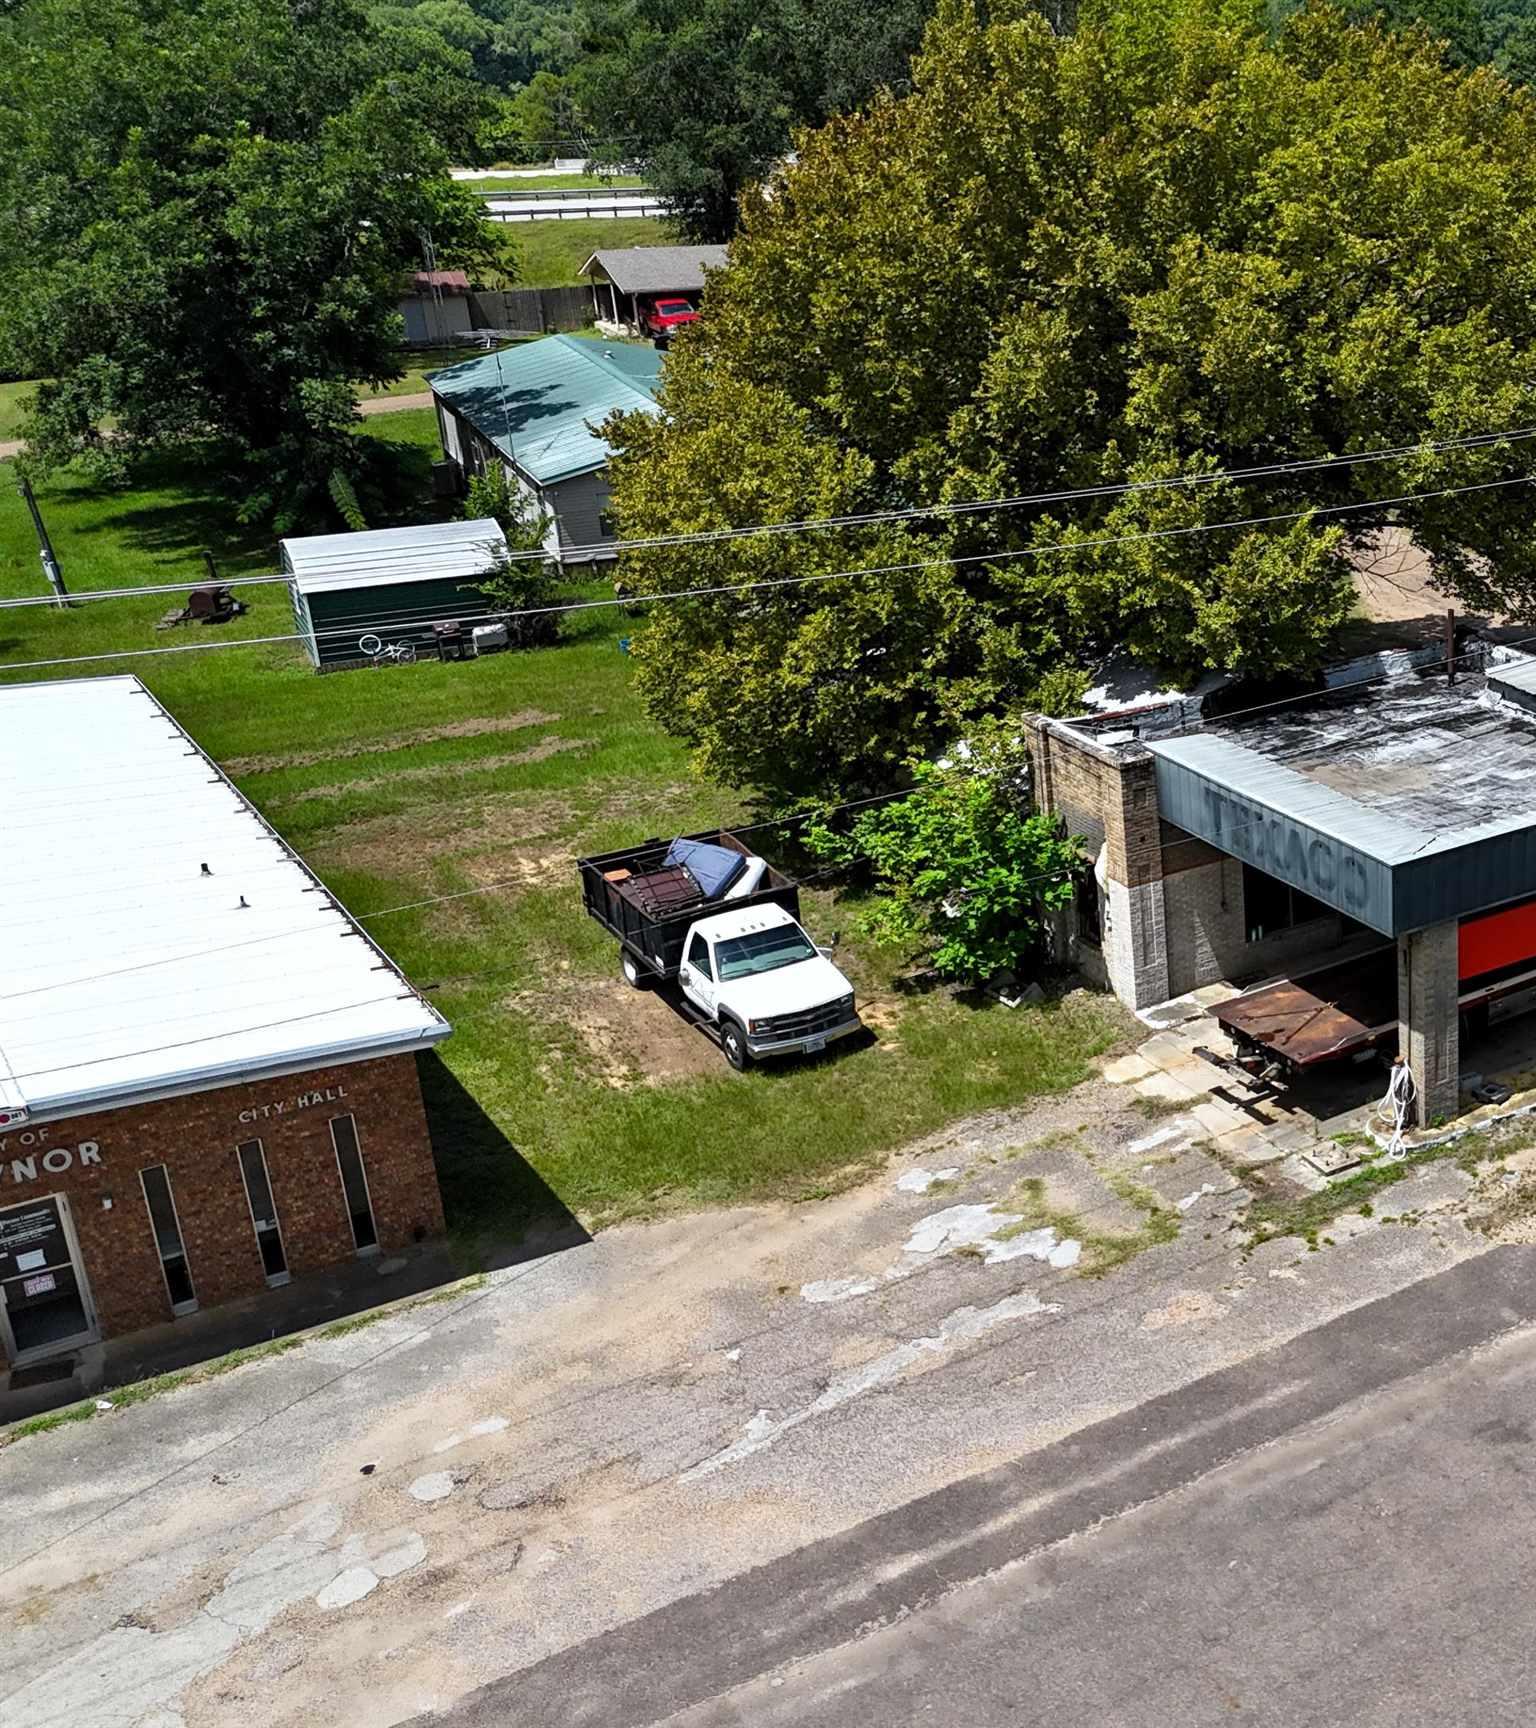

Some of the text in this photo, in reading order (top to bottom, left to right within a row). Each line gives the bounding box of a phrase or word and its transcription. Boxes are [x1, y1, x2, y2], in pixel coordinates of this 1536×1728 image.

[238, 1085, 348, 1123] CITY HALL
[20, 1127, 48, 1145] OF
